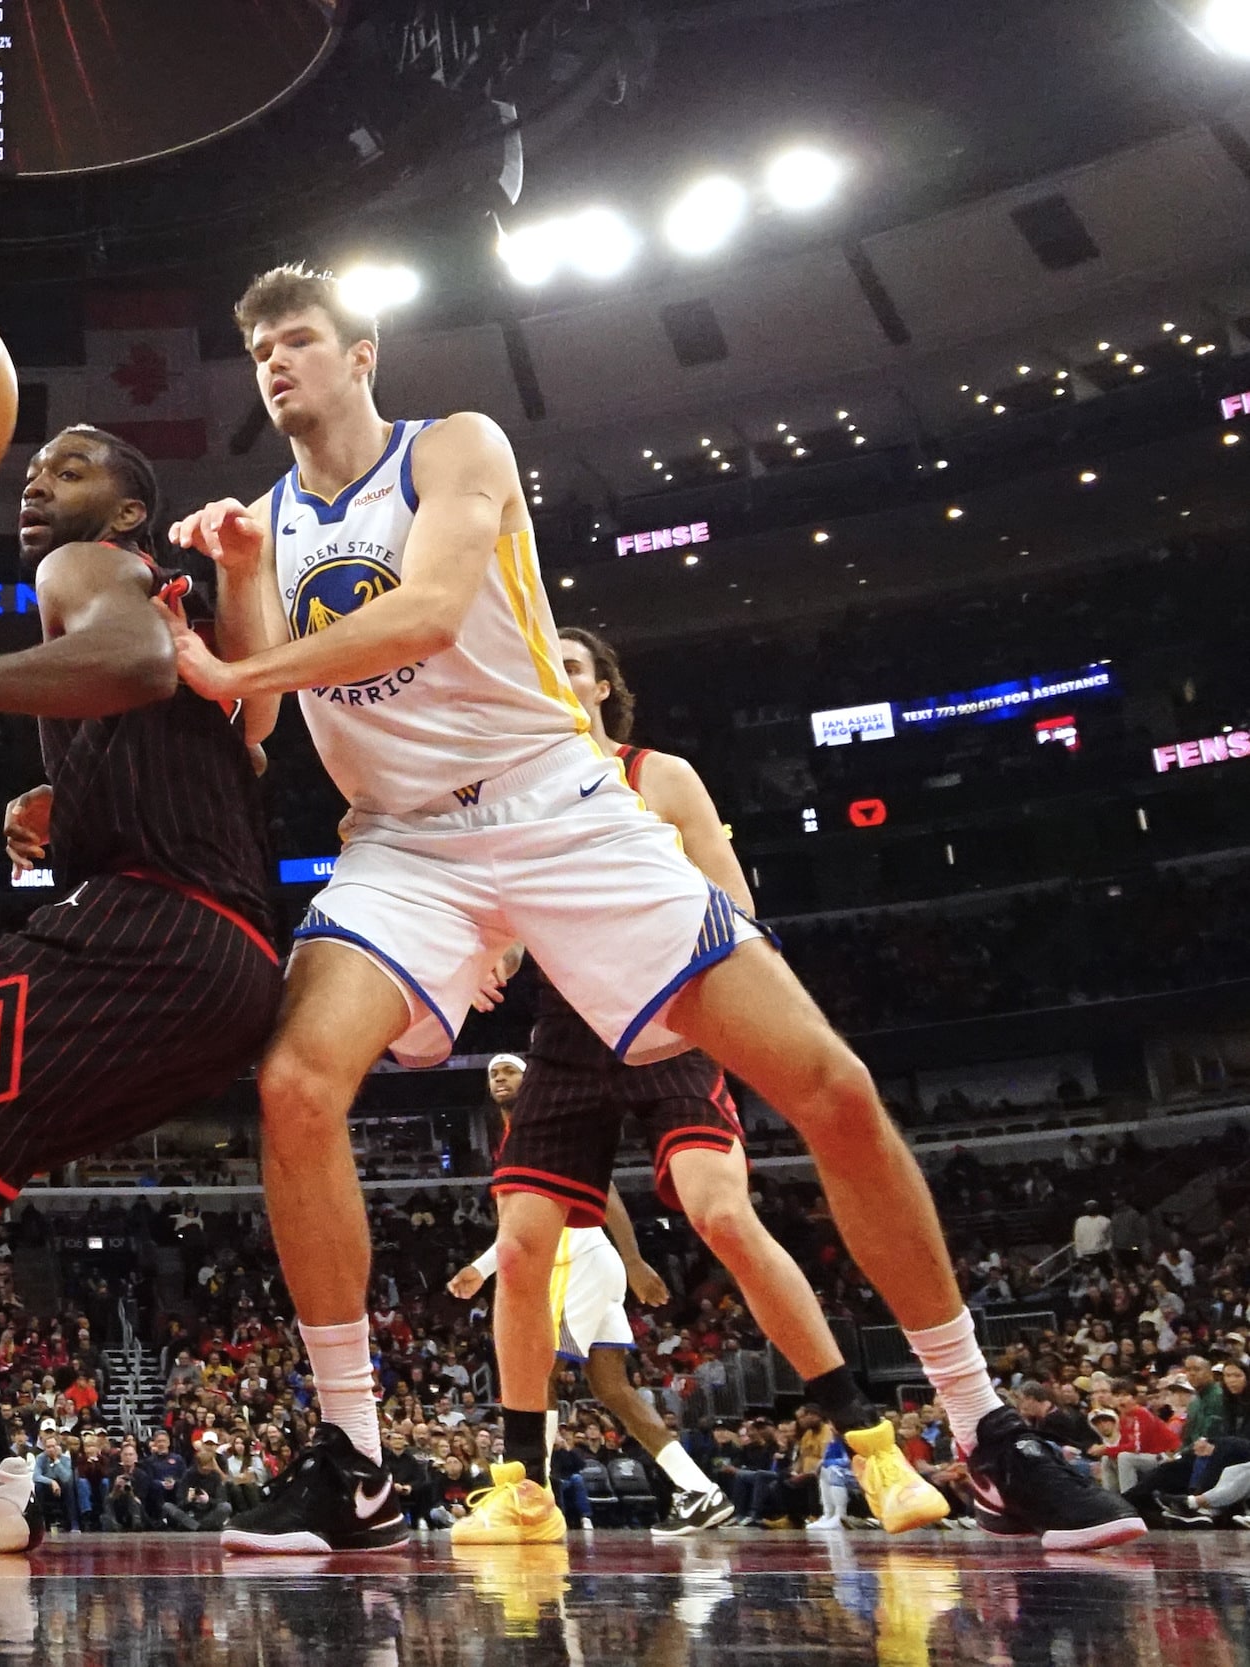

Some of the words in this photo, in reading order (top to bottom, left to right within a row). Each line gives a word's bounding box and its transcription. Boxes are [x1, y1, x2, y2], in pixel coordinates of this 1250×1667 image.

[617, 522, 709, 557] FENSE
[286, 543, 338, 600] GOLDEN
[347, 541, 395, 563] STATE
[312, 662, 425, 707] WARRIO
[902, 709, 933, 721] TEXT
[935, 706, 957, 717] 773
[1004, 691, 1030, 705] FOR
[1033, 674, 1109, 699] ASSISTANCE
